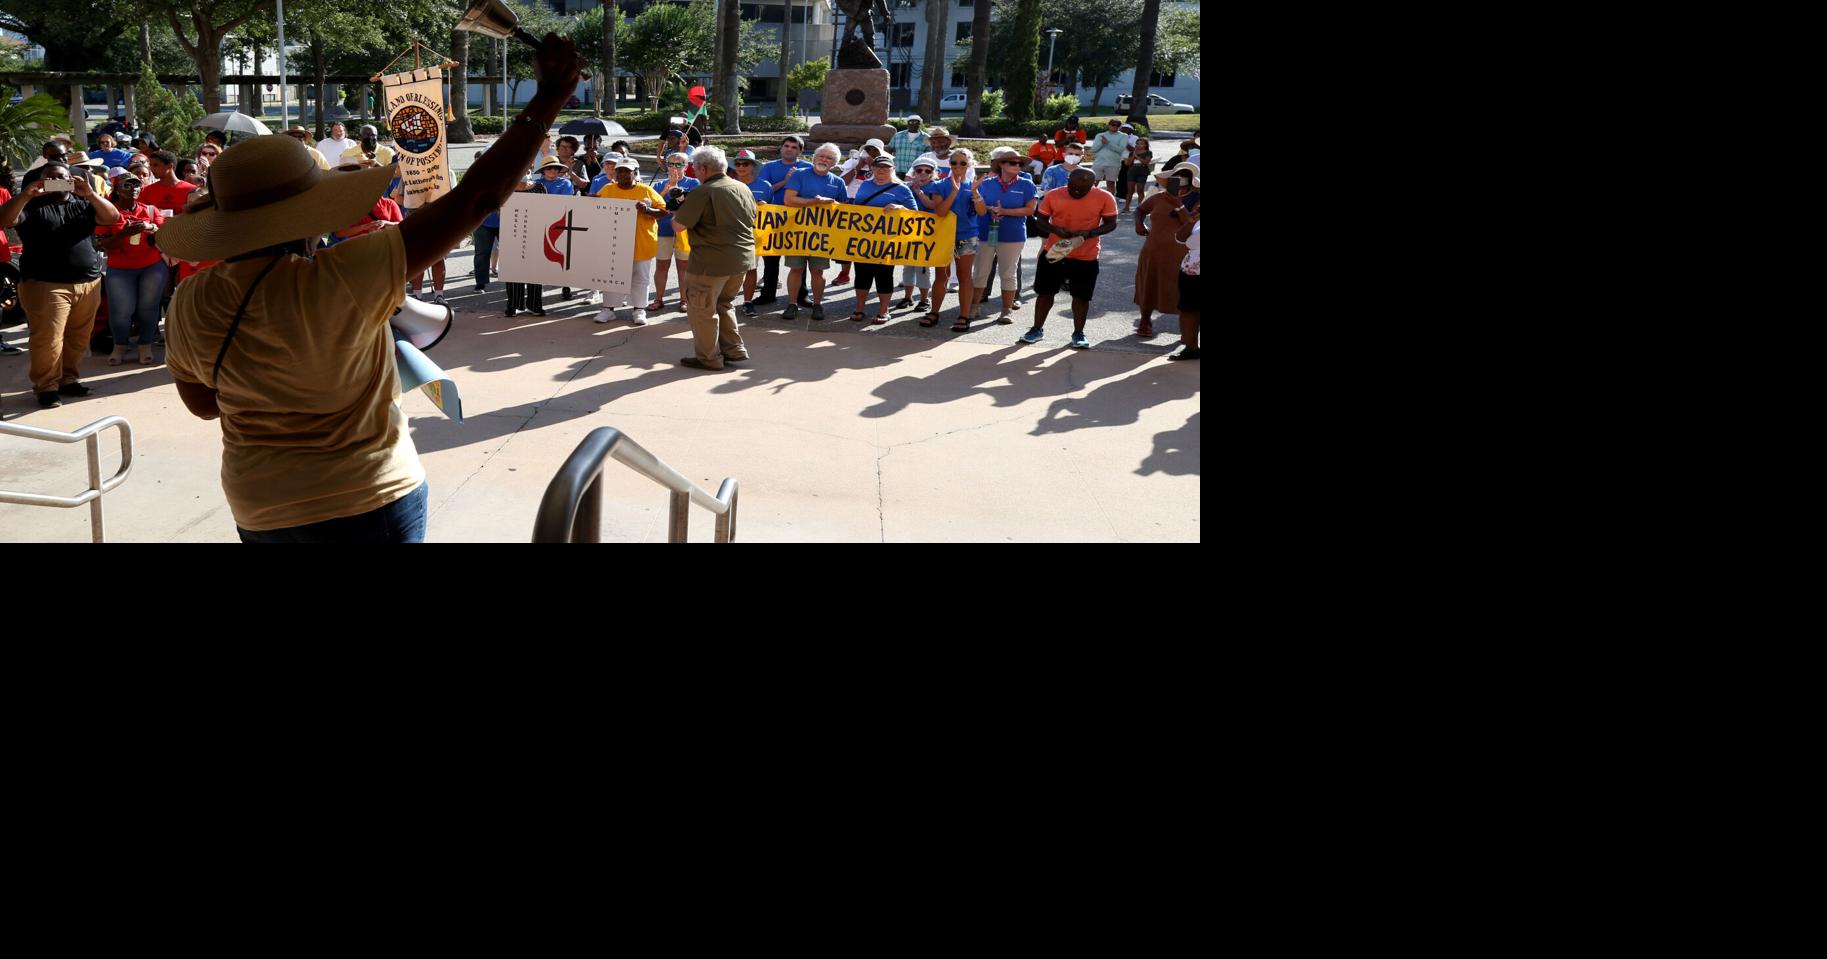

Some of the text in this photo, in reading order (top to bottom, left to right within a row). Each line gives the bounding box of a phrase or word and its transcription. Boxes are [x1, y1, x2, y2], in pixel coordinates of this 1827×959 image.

[753, 206, 936, 237] IAN UNIVERSALISTS
[610, 211, 619, 278] METHODIST
[763, 231, 936, 261] JUSTICE, EQUALITY
